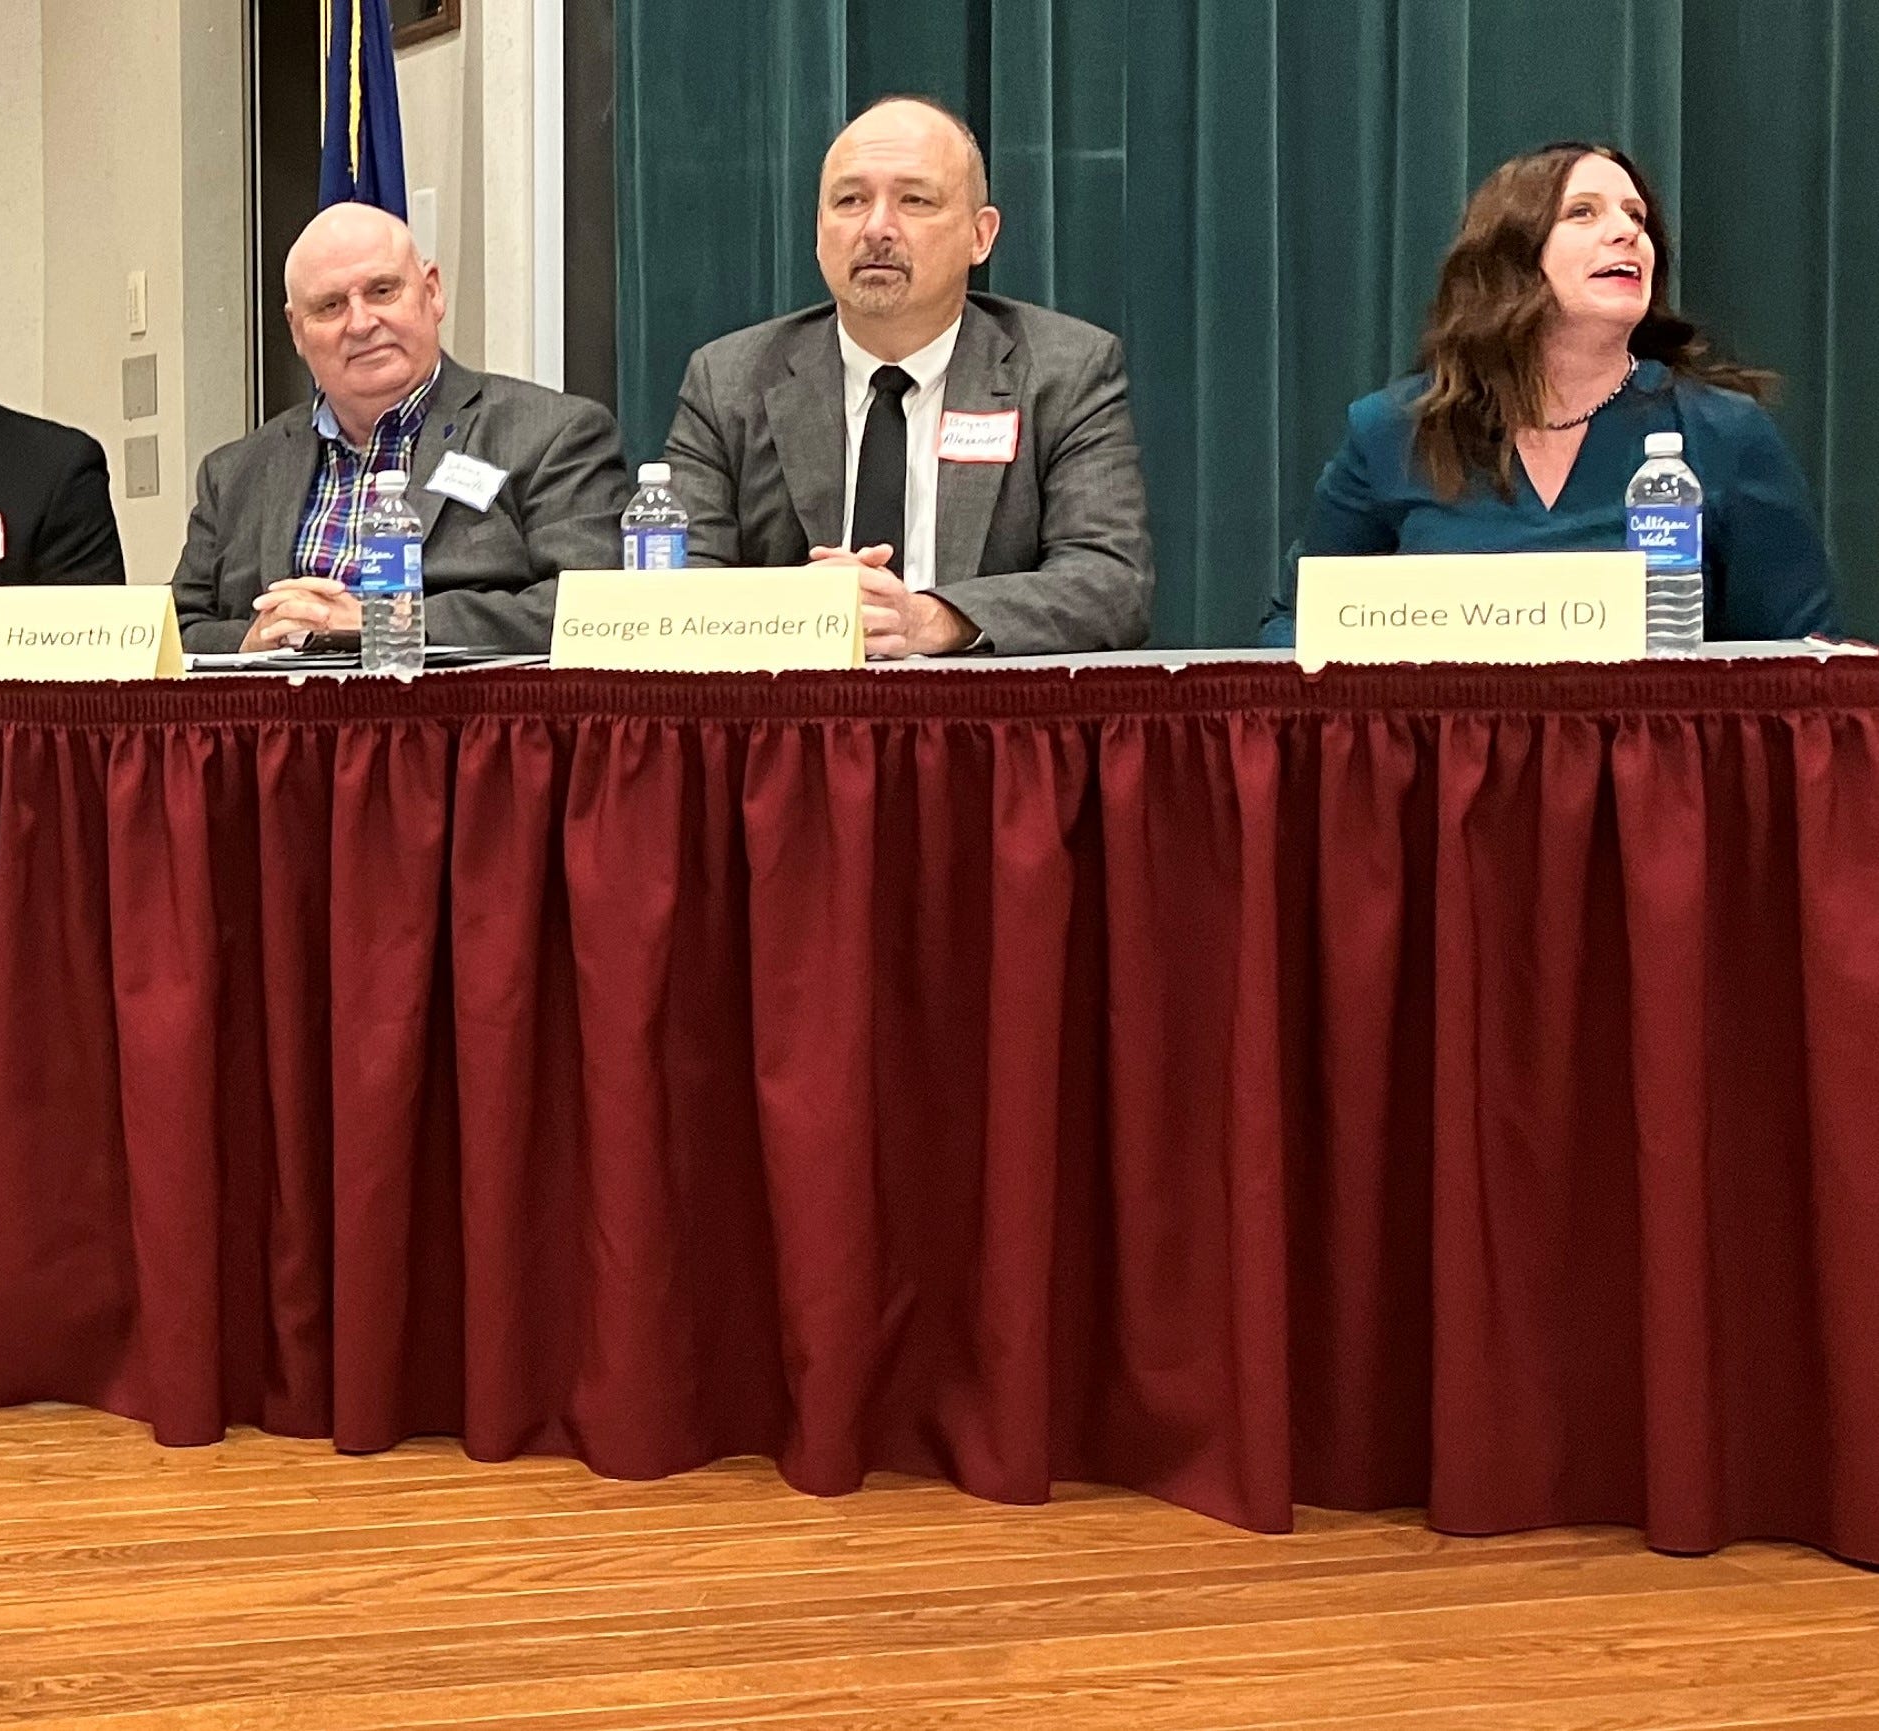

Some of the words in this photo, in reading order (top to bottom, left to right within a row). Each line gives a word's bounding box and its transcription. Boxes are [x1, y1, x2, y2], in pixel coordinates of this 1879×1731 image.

[1630, 515, 1691, 537] Culligan
[562, 617, 650, 642] George
[659, 616, 673, 636] B
[681, 614, 808, 636] Alexander
[815, 613, 850, 639] (R)
[1338, 602, 1449, 628] Cindee
[1460, 601, 1546, 626] Ward
[1560, 599, 1607, 631] (D)
[7, 624, 111, 646] Haworth
[119, 623, 156, 650] (D)
